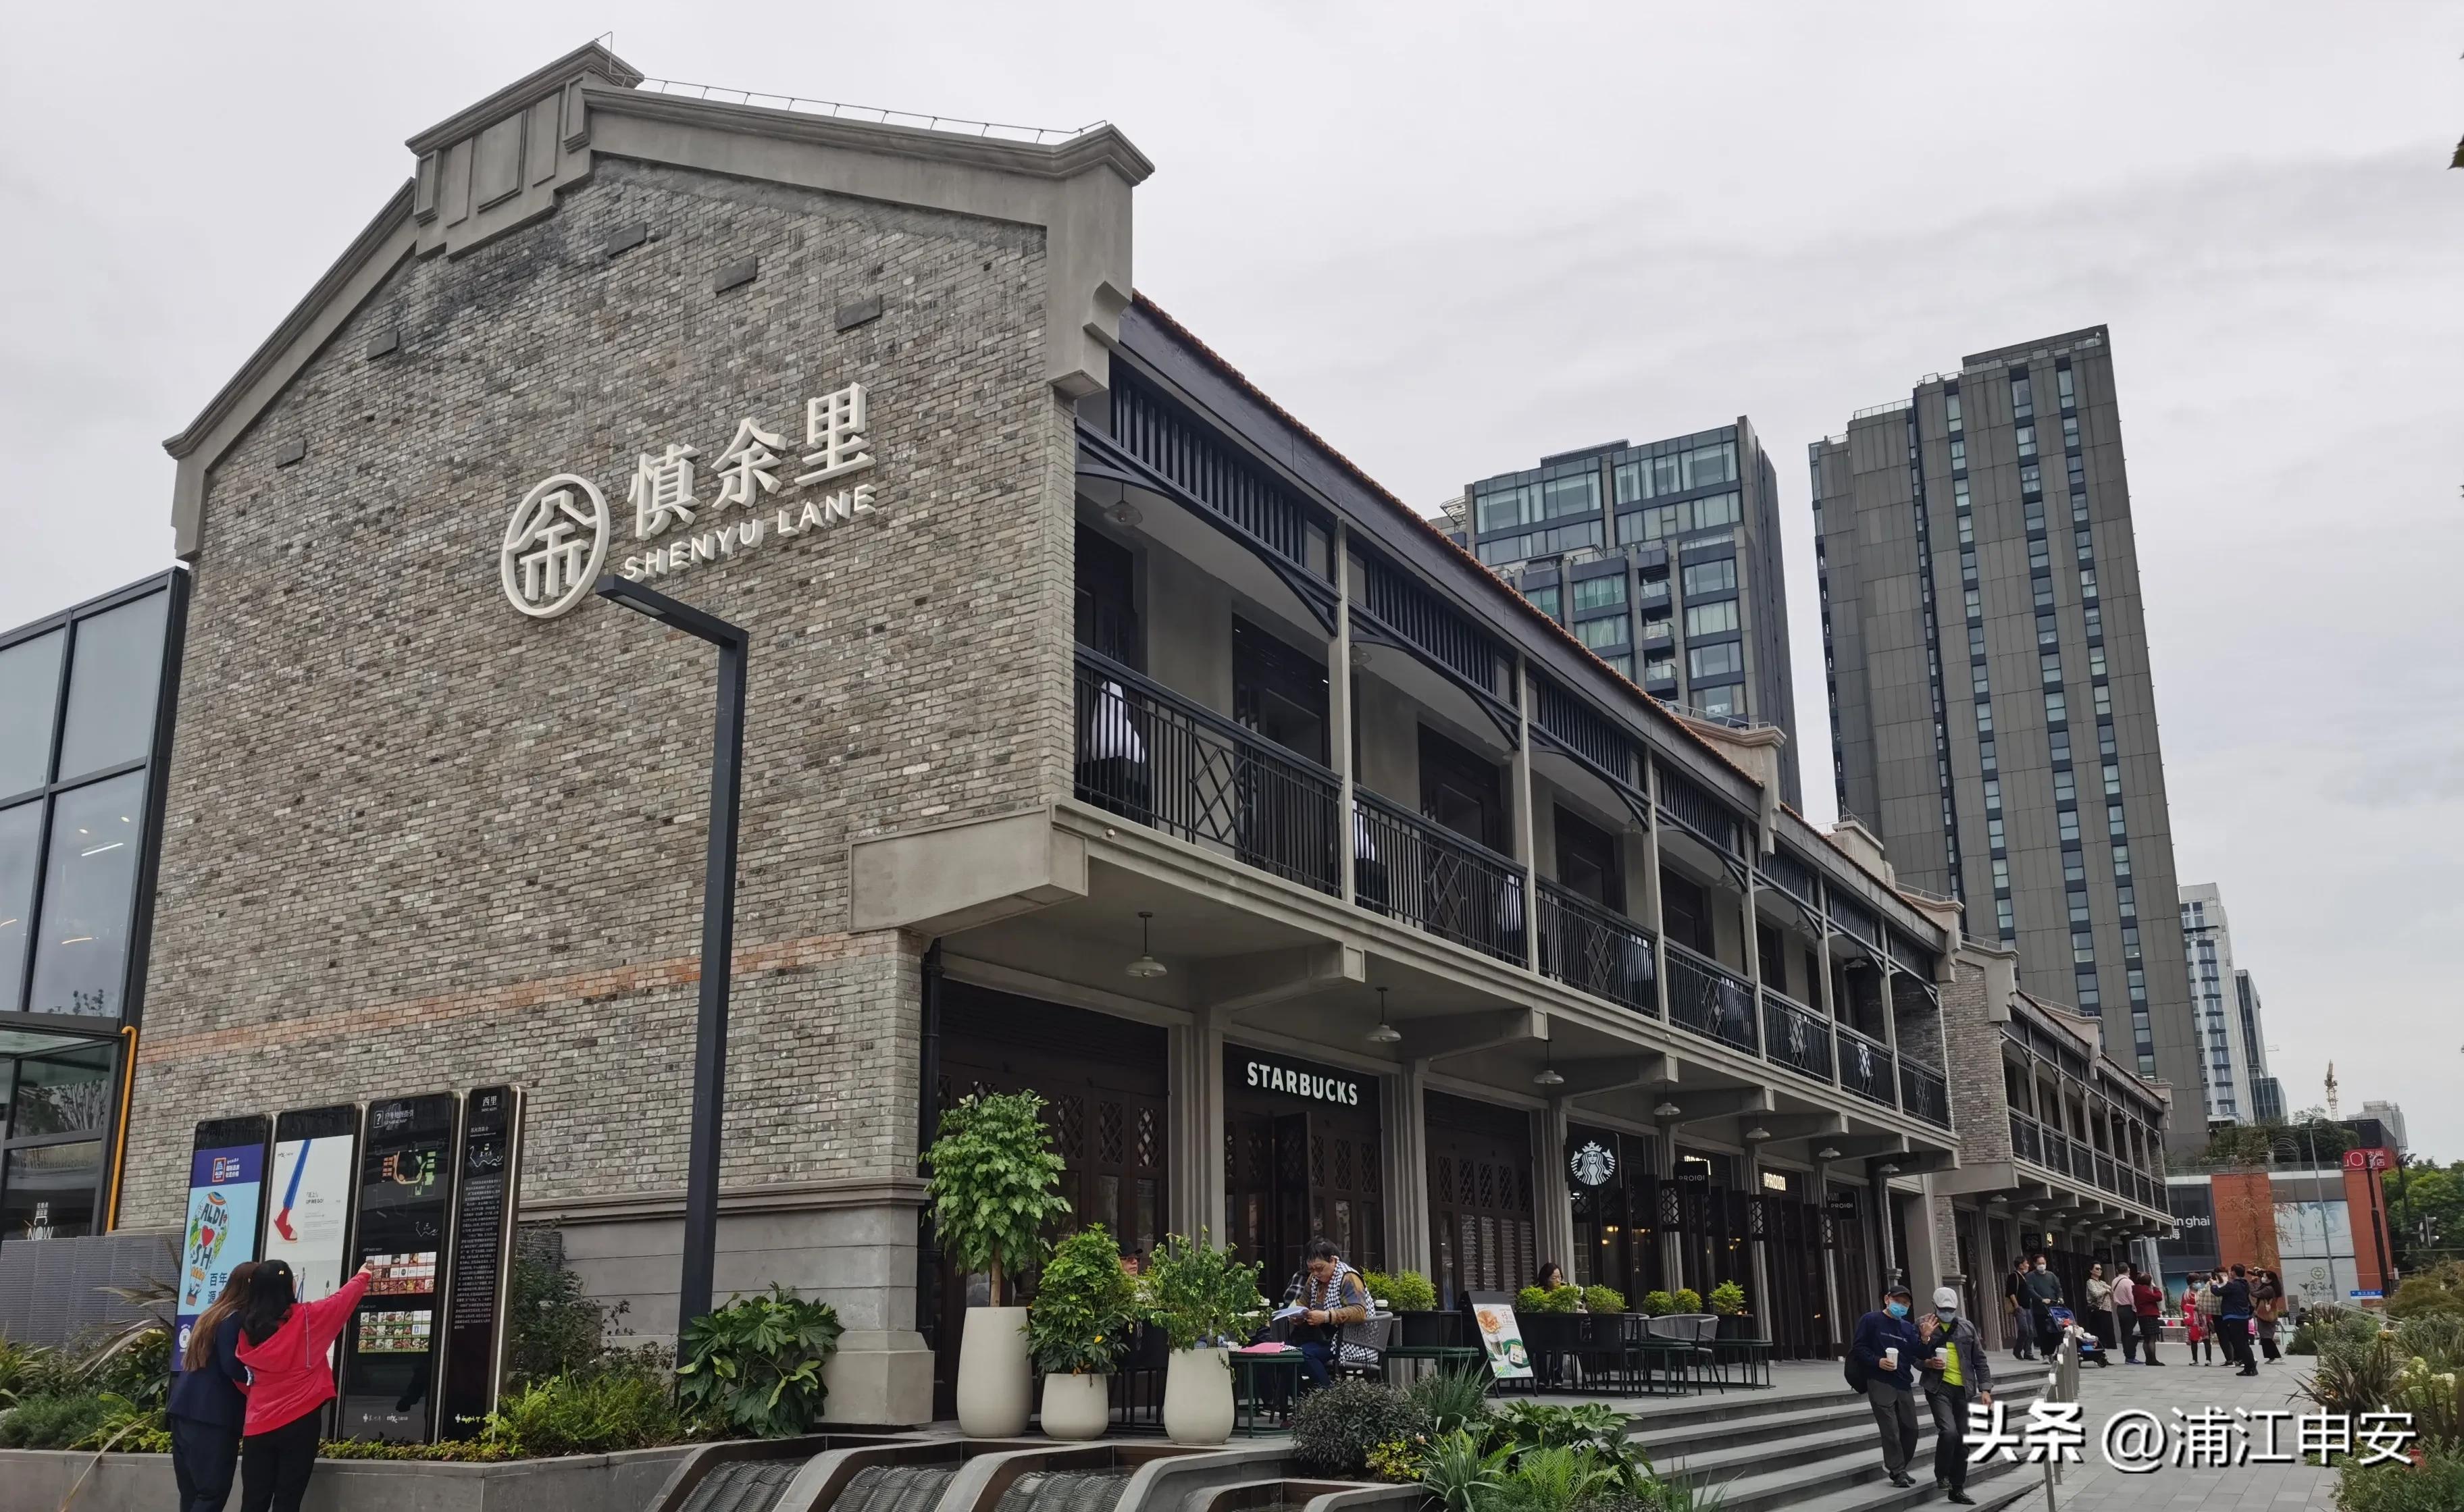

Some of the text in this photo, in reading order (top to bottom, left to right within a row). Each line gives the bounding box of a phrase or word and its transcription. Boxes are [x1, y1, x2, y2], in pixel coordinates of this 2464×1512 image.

[627, 382, 876, 540] 慎余里
[623, 484, 876, 583] SHENYU LANE
[1247, 1062, 1358, 1105] STARBUCKS
[201, 1203, 225, 1226] ALDI
